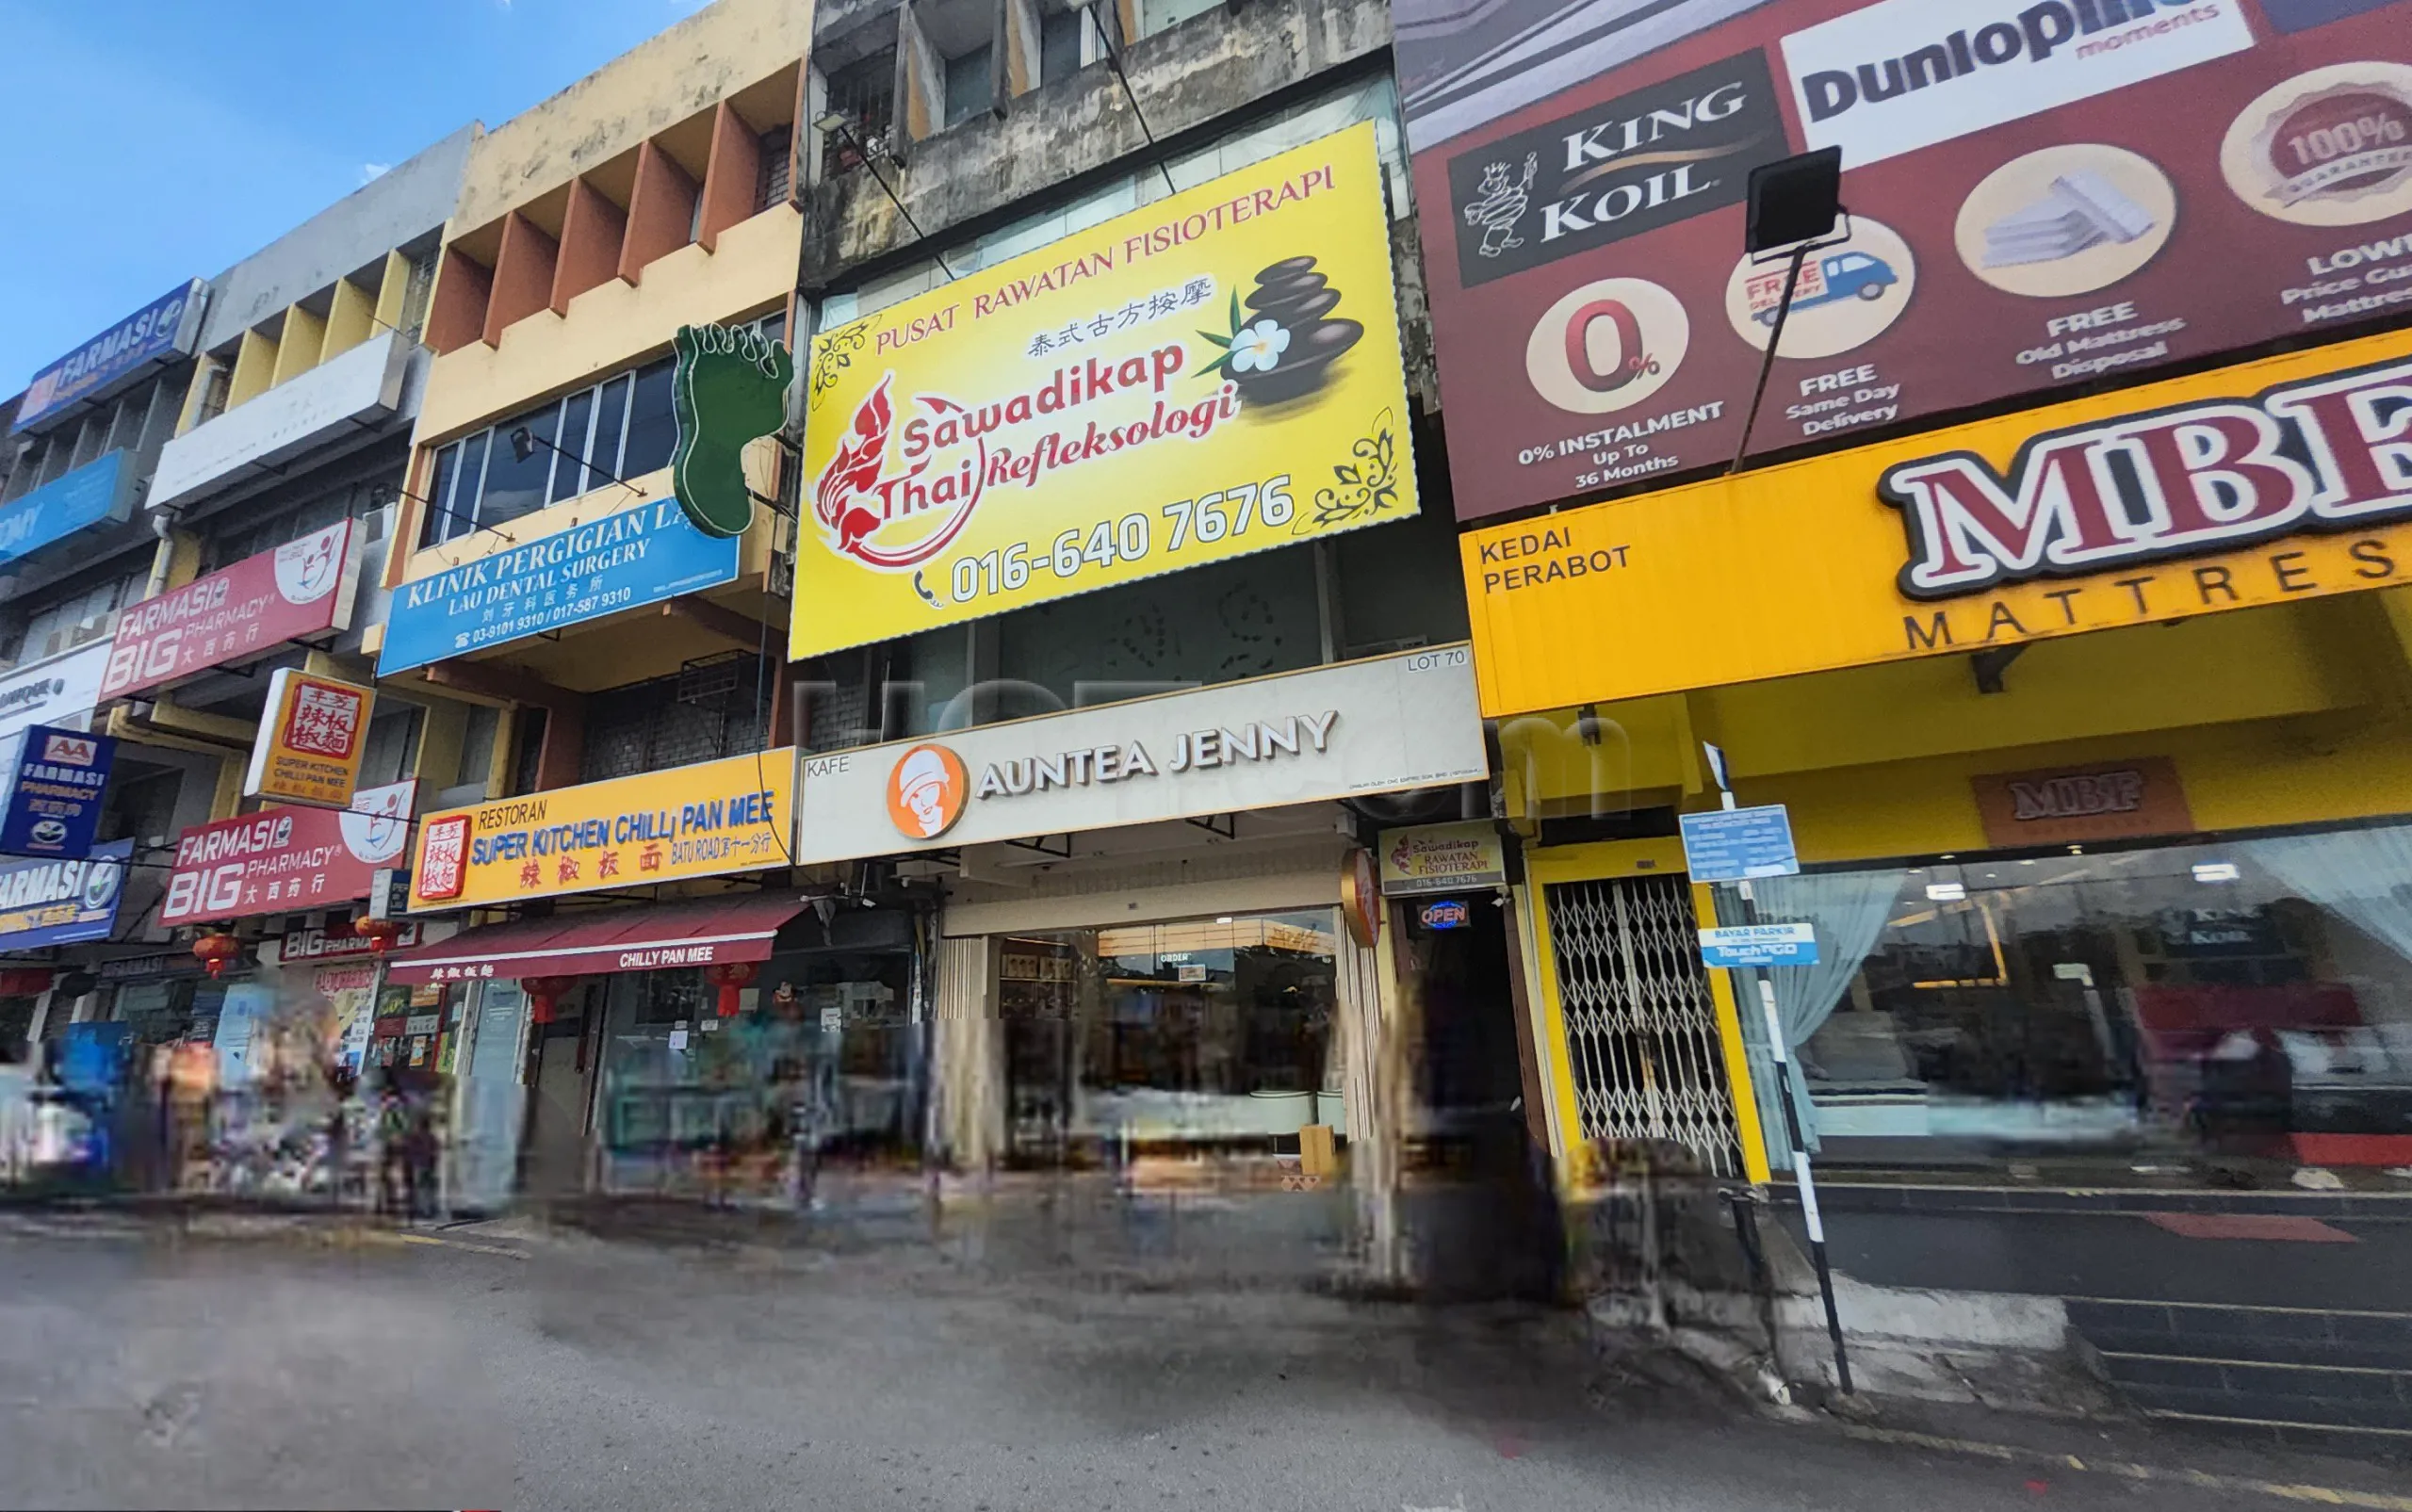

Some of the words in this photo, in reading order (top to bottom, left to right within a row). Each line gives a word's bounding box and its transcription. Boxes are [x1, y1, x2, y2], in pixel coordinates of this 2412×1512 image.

[2076, 4, 2220, 60] moments
[1562, 82, 1748, 174] KING
[2288, 113, 2405, 165] 100%
[1540, 164, 1711, 246] KOIL
[875, 302, 961, 355] PUSAT
[972, 246, 1116, 318] RAWATAN
[1123, 164, 1336, 266] FISIOTERAPI
[1746, 268, 1820, 301] FRE
[1027, 278, 1212, 358] 泰式古方按摩
[2046, 301, 2139, 338] FREE
[57, 307, 159, 388] FARMASI
[2016, 343, 2063, 365] Old
[2066, 317, 2188, 354] Mattress
[2051, 340, 2168, 380] Disposal
[902, 340, 1185, 459] Sawadikap
[1785, 393, 1850, 420] Same
[1854, 381, 1901, 411] Day
[1800, 364, 1879, 398] FREE
[1518, 444, 1555, 465] 0%
[1559, 400, 1725, 458] INSTALMENT
[1802, 404, 1899, 437] Delivery
[875, 456, 972, 522] Thai
[986, 383, 1239, 489] Refleksologi
[1575, 473, 1600, 489] 36
[1603, 454, 1679, 483] Months
[1592, 446, 1622, 468] Up
[1624, 441, 1649, 458] To
[406, 561, 491, 610] KLINIK
[495, 508, 646, 580] PERGIGIAN
[949, 512, 1152, 604] 016-640
[1162, 474, 1297, 552] 7676
[1479, 526, 1573, 565] KEDAI
[448, 593, 483, 617] LAU
[486, 571, 560, 607] DENTAL
[562, 538, 651, 582] SURGERY
[1483, 544, 1633, 595] PERABOT
[115, 581, 215, 645] FARMASI
[472, 621, 514, 645] 03-9101
[515, 611, 545, 632] 9310
[552, 594, 600, 623] 017-587
[601, 586, 632, 609] 9310
[103, 628, 183, 694] BIG
[185, 596, 269, 642] PHARMACY
[1407, 652, 1440, 674] LOT
[1443, 650, 1466, 668] 70
[50, 739, 91, 759] AA
[276, 756, 309, 770] SUPER
[310, 761, 349, 775] KITCHEN
[807, 756, 850, 780] KAFE
[975, 740, 1157, 802] AUNTEA
[1168, 708, 1340, 774] JENNY
[23, 762, 106, 787] FARMASI
[274, 769, 303, 781] CHILLI
[305, 773, 324, 785] PAN
[327, 777, 346, 789] MEE
[471, 831, 530, 866] SUPER
[531, 819, 611, 857] KITCHEN
[615, 811, 676, 845] CHILLI
[681, 799, 724, 836] PAN
[727, 790, 774, 829] MEE
[478, 799, 547, 831] RESTORAN
[176, 818, 277, 868] FARMASI
[671, 839, 694, 866] BATU
[695, 836, 720, 862] ROAD
[1412, 839, 1478, 854] Sawadikap
[1425, 851, 1478, 865] RAWATAN
[0, 859, 86, 910] ARMASI
[162, 862, 246, 919] BIG
[246, 846, 334, 879] PHARMACY
[520, 842, 662, 889] 辣椒板面
[1416, 877, 1454, 887] 016-640
[1456, 874, 1477, 884] 7676
[1419, 860, 1489, 875] FISIOTERAPI
[1421, 906, 1466, 923] OPEN
[1714, 927, 1751, 938] BAYAR
[1753, 926, 1796, 936] PARKIR
[285, 929, 325, 957] BIG
[325, 935, 371, 951] PHARMA
[619, 951, 660, 968] CHILLY
[661, 949, 685, 965] PAN
[686, 946, 713, 963] MEE
